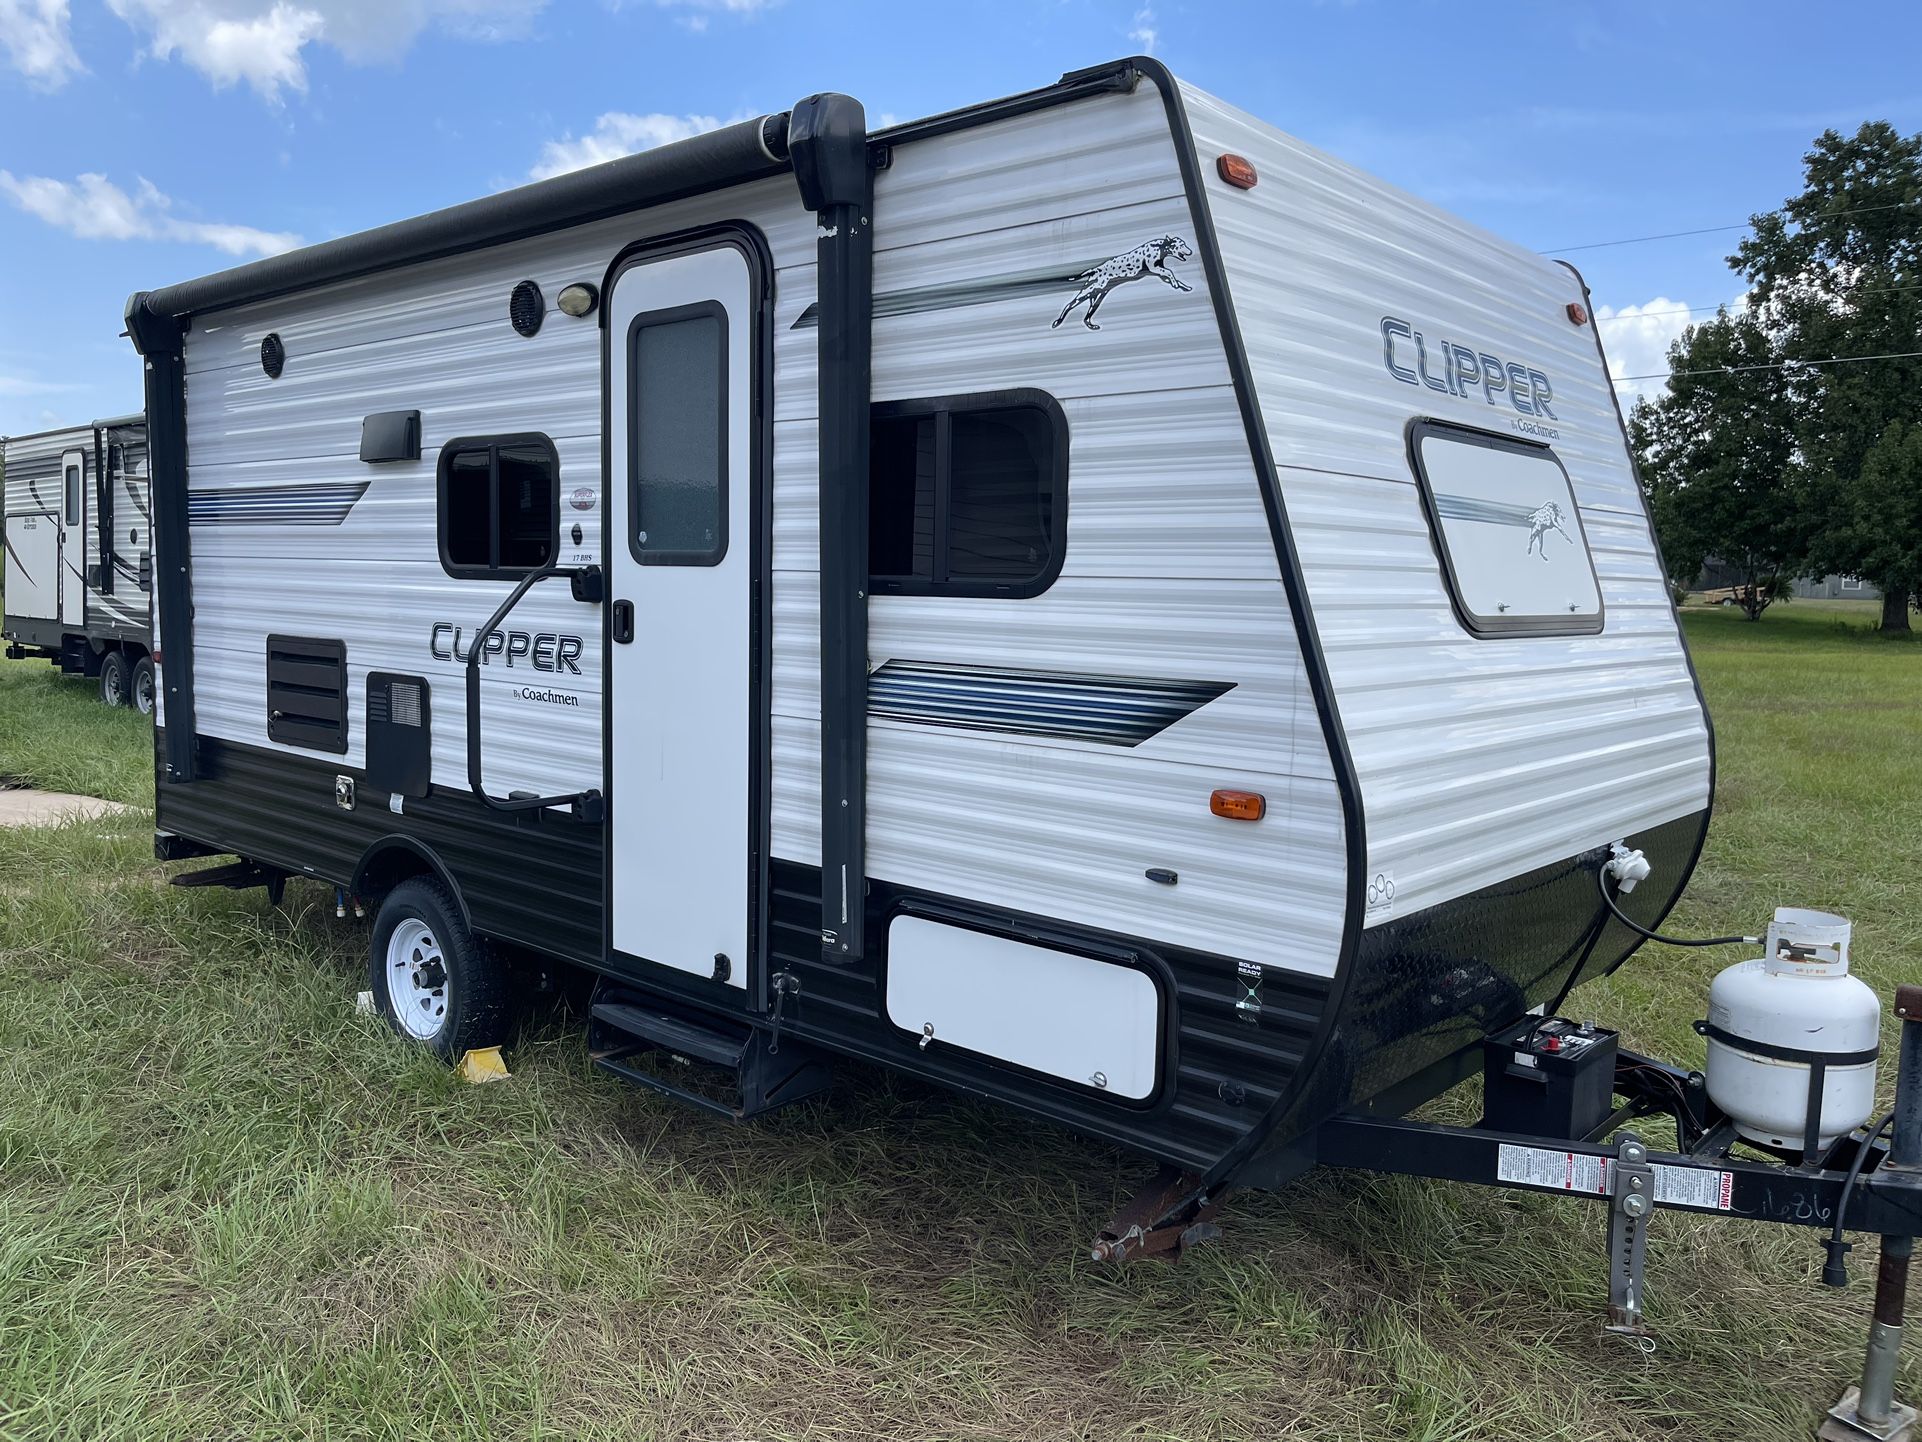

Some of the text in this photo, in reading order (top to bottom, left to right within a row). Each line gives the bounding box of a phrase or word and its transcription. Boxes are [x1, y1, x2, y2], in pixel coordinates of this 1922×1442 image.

[1381, 315, 1559, 421] CLIPPER
[1518, 418, 1560, 440] Coachmen
[513, 687, 579, 706] By Coachmen
[1238, 961, 1262, 971] SOLAR
[1238, 967, 1262, 976] READY
[1720, 1173, 1732, 1208] PROPANE
